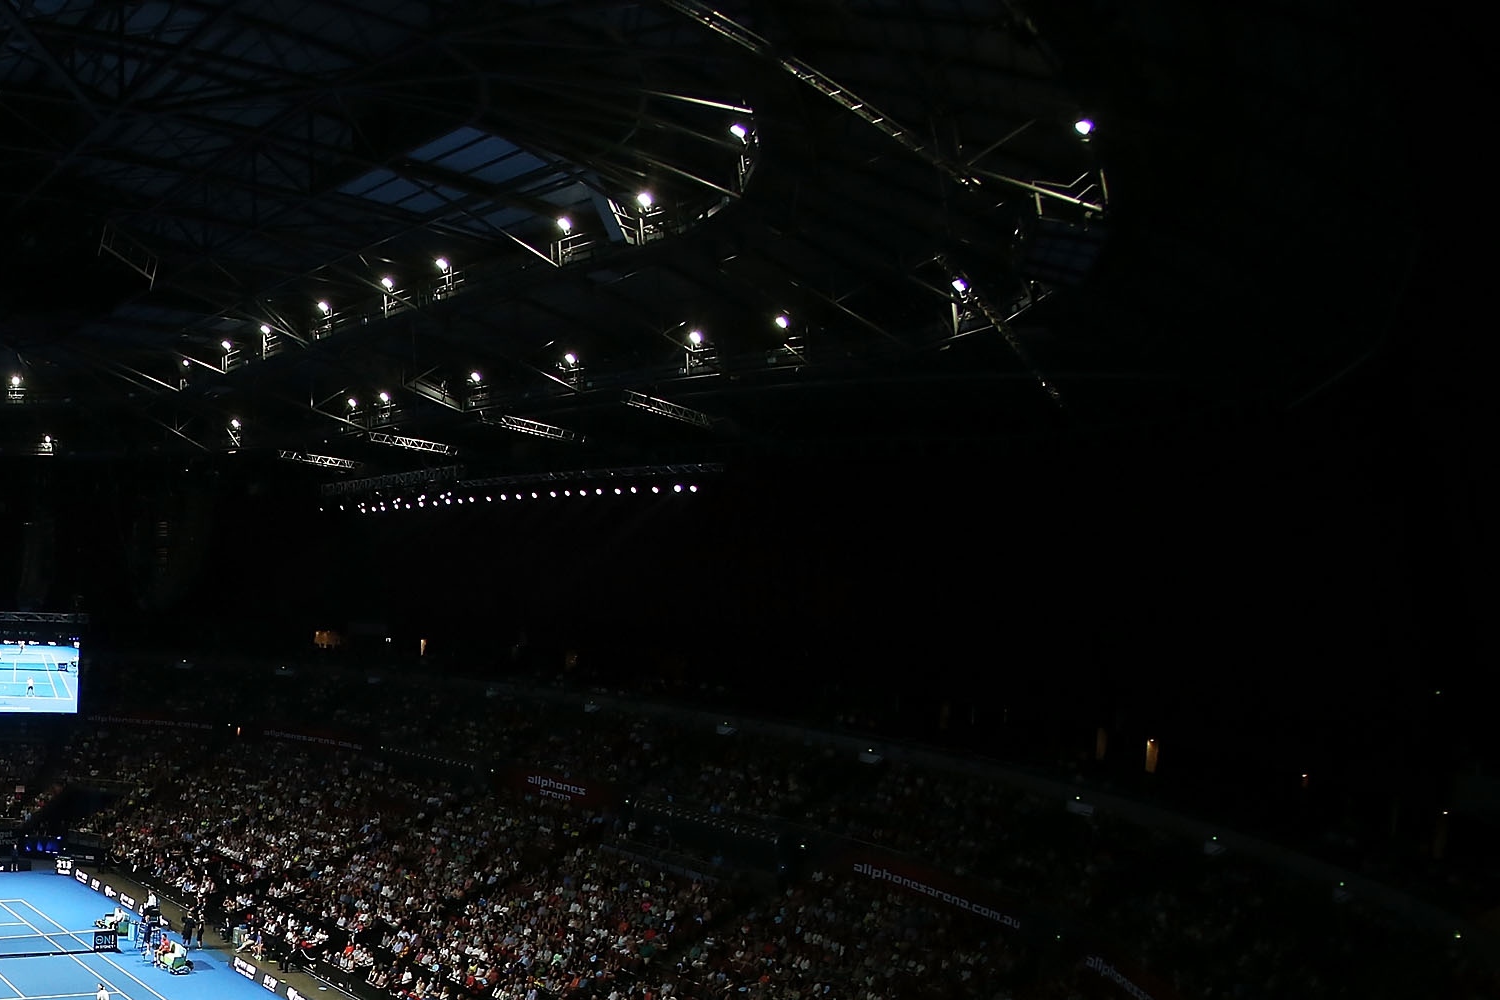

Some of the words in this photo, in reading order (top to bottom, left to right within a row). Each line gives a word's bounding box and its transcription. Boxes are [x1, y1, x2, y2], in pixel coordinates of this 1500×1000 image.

[527, 775, 587, 797] allphones
[539, 787, 571, 801] arena
[853, 863, 1021, 930] allphonesarena.com.au
